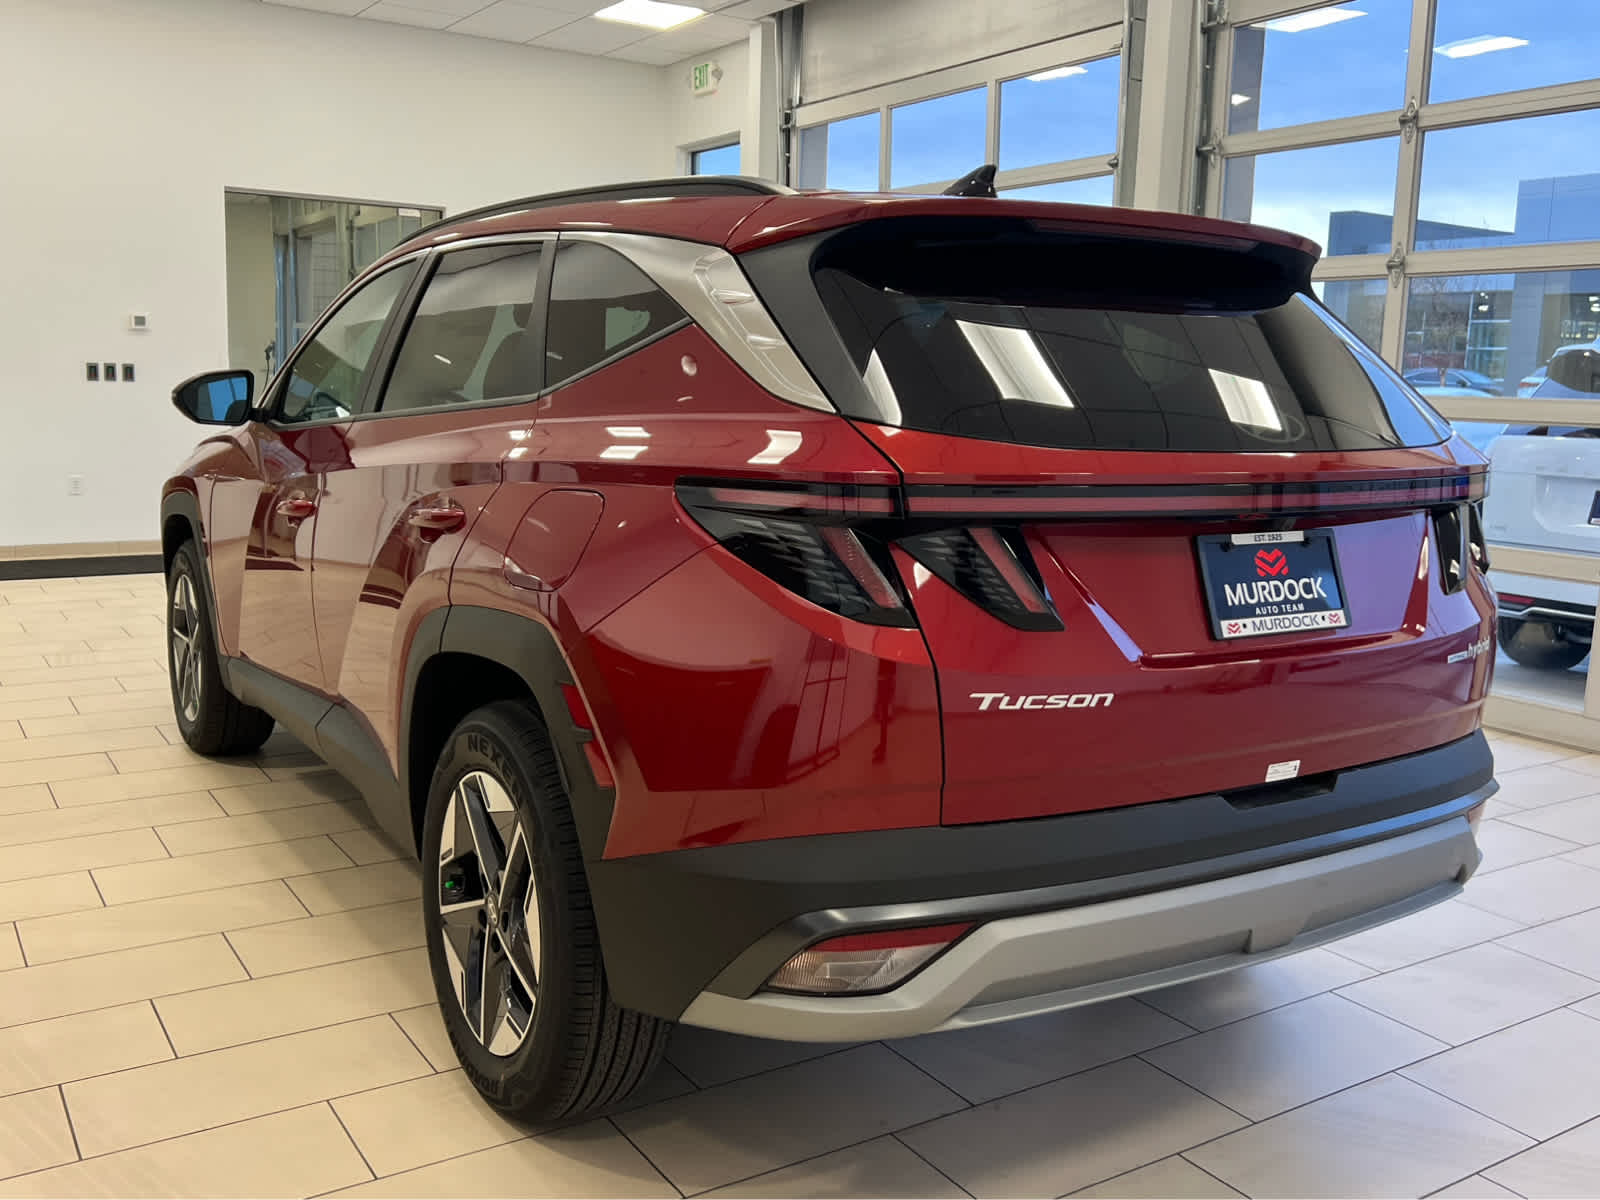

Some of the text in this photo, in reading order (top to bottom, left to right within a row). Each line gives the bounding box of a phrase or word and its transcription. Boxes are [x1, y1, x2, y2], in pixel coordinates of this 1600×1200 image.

[1223, 576, 1328, 606] MURDOCK
[1255, 603, 1305, 615] AUTO TEAM
[1252, 614, 1320, 632] MURDOCK
